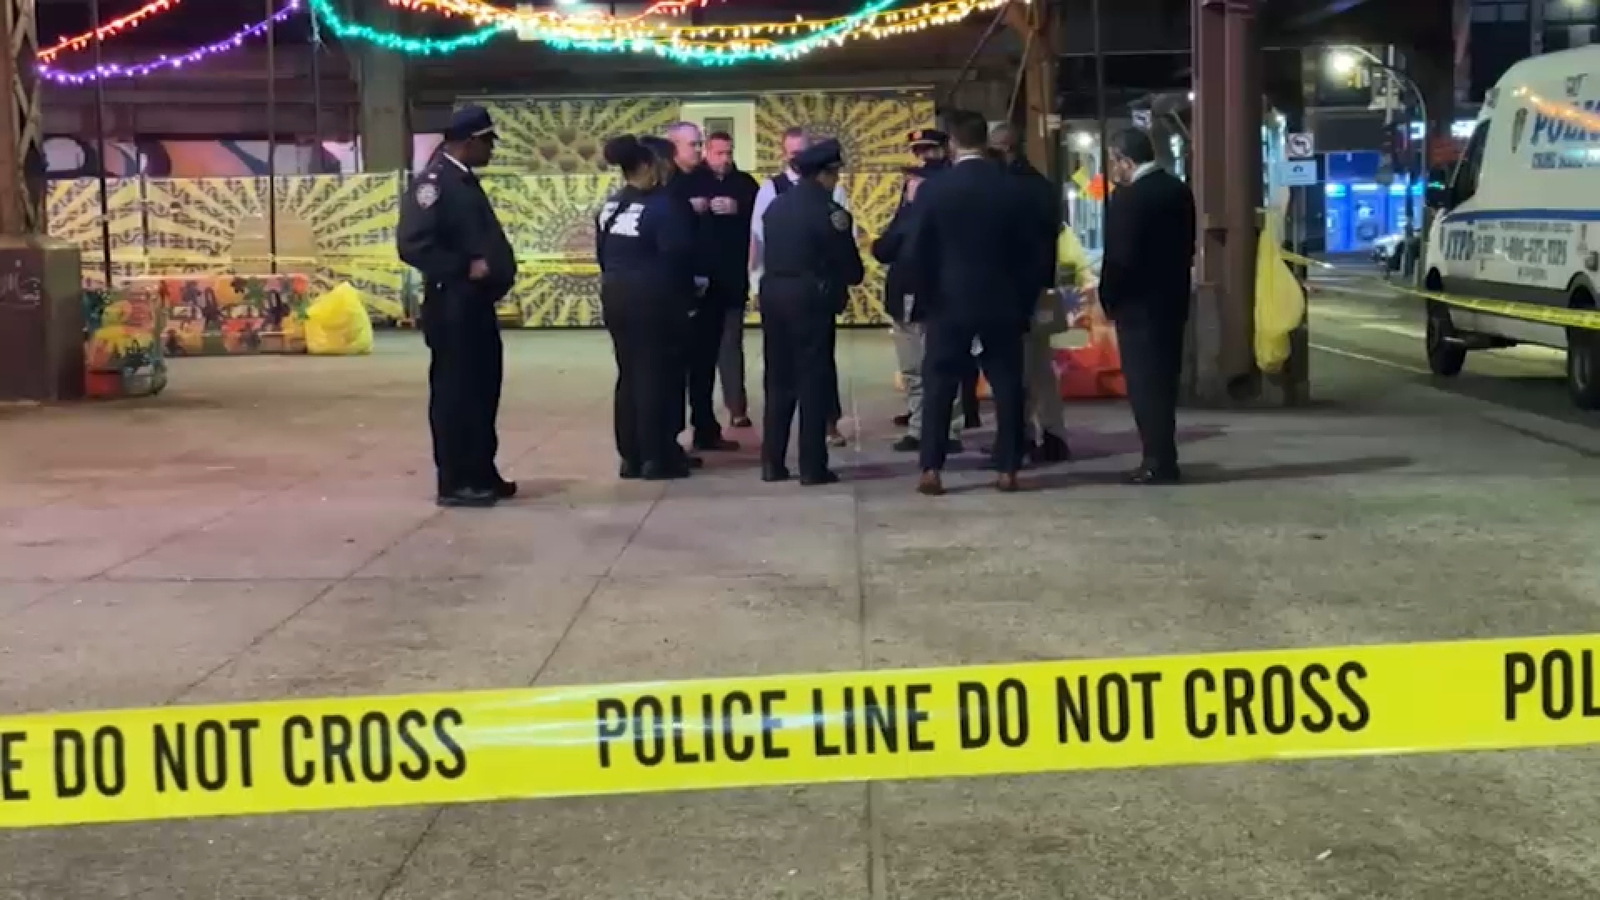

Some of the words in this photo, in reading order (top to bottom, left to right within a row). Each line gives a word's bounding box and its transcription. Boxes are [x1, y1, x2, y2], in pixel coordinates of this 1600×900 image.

[54, 725, 126, 799] DO
[153, 718, 260, 793] NOT
[282, 707, 468, 787] CROSS
[597, 690, 789, 769] POLICE
[813, 683, 935, 757] LINE
[958, 678, 1030, 751] DO
[1056, 671, 1163, 744] NOT
[1184, 661, 1371, 739] CROSS
